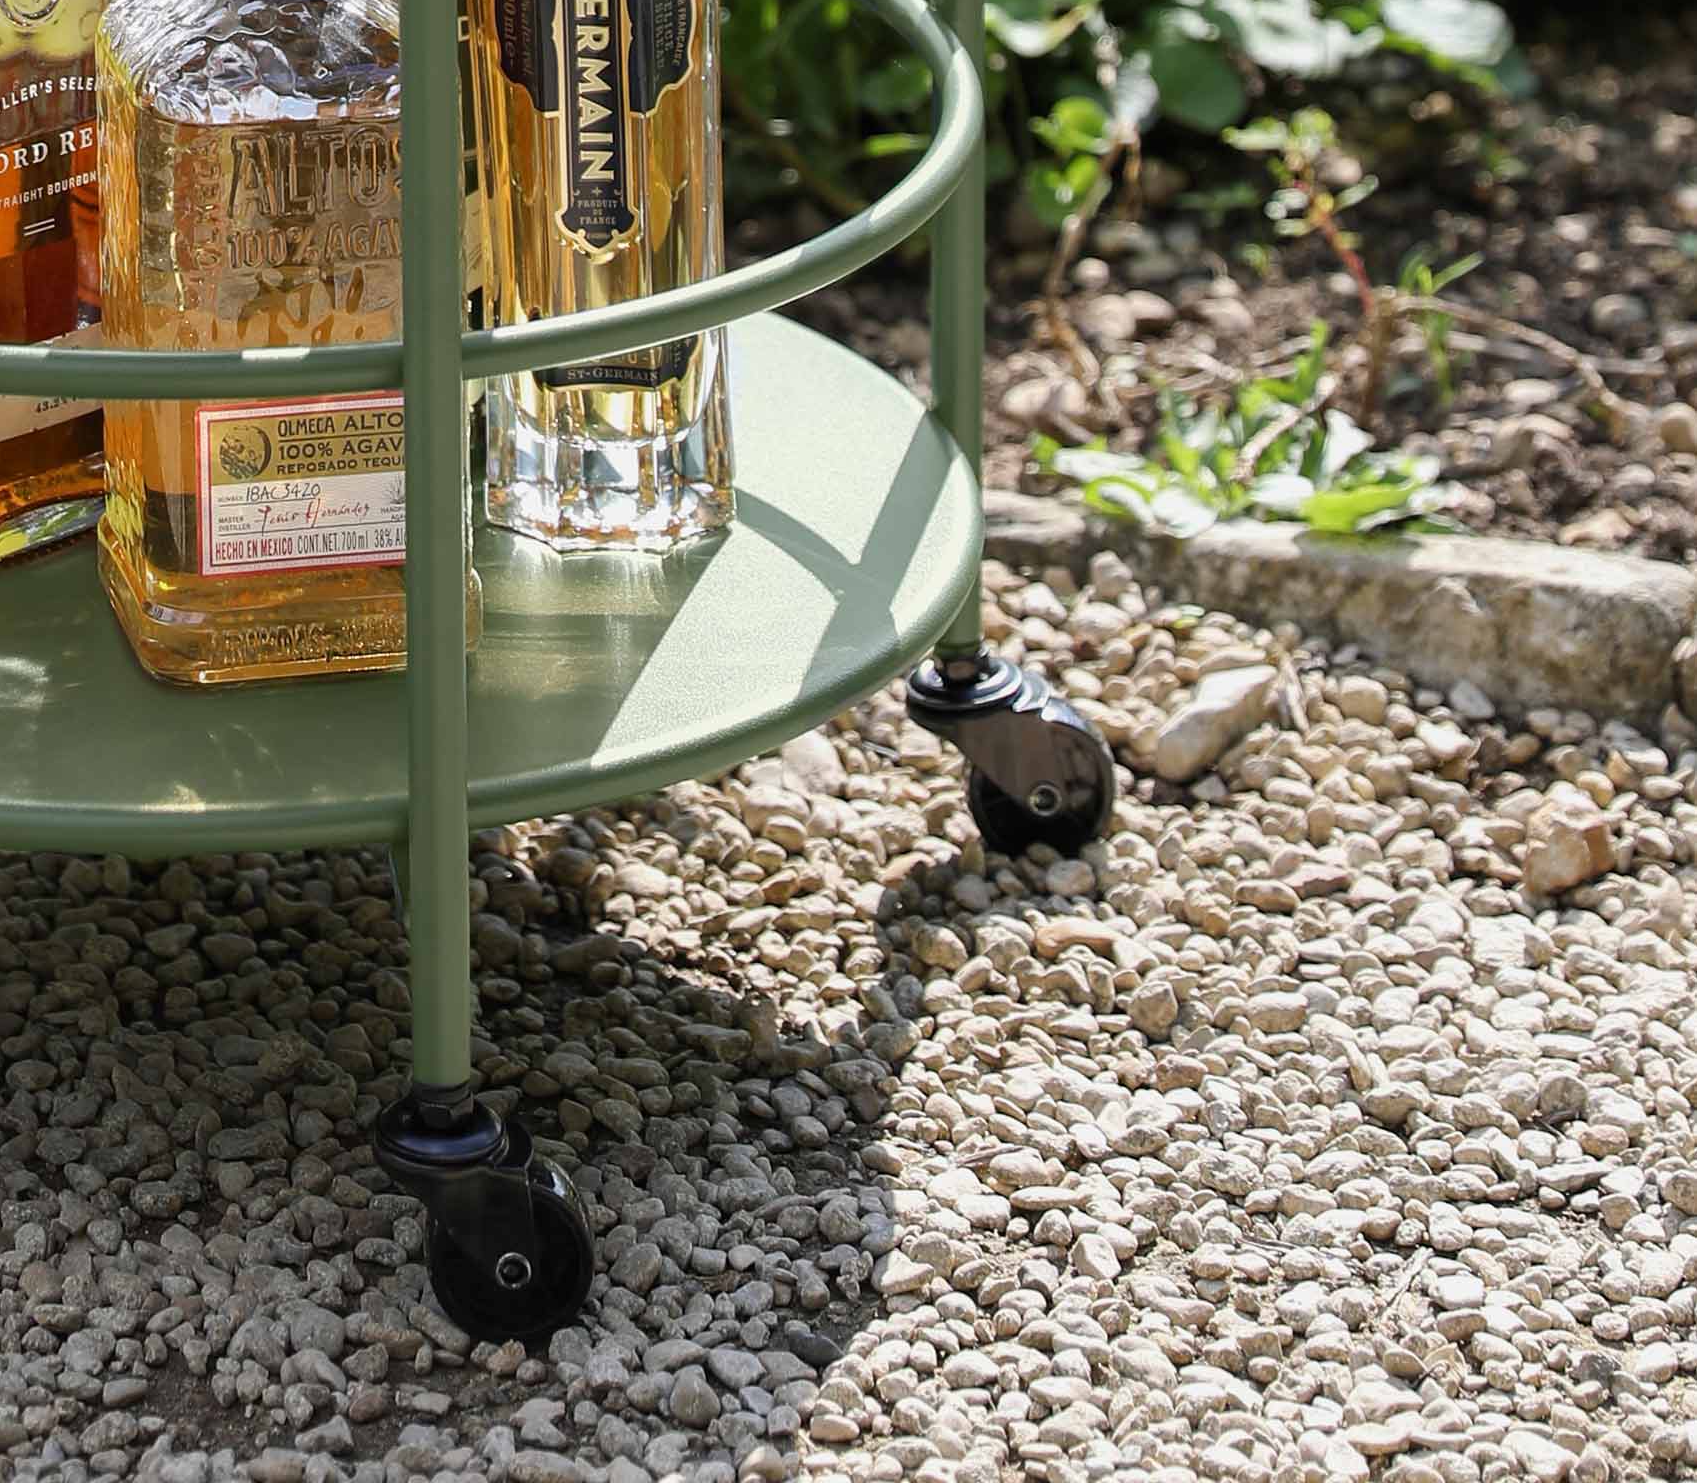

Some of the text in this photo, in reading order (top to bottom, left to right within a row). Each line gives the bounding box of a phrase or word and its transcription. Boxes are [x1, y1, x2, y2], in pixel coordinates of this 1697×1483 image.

[47, 170, 97, 196] BOURBON
[277, 416, 336, 437] OLMECA
[278, 443, 333, 460] 100%
[277, 457, 359, 475] REPOSADO
[215, 540, 244, 561] HECHO
[247, 539, 259, 559] EN
[260, 537, 293, 557] MEXICO
